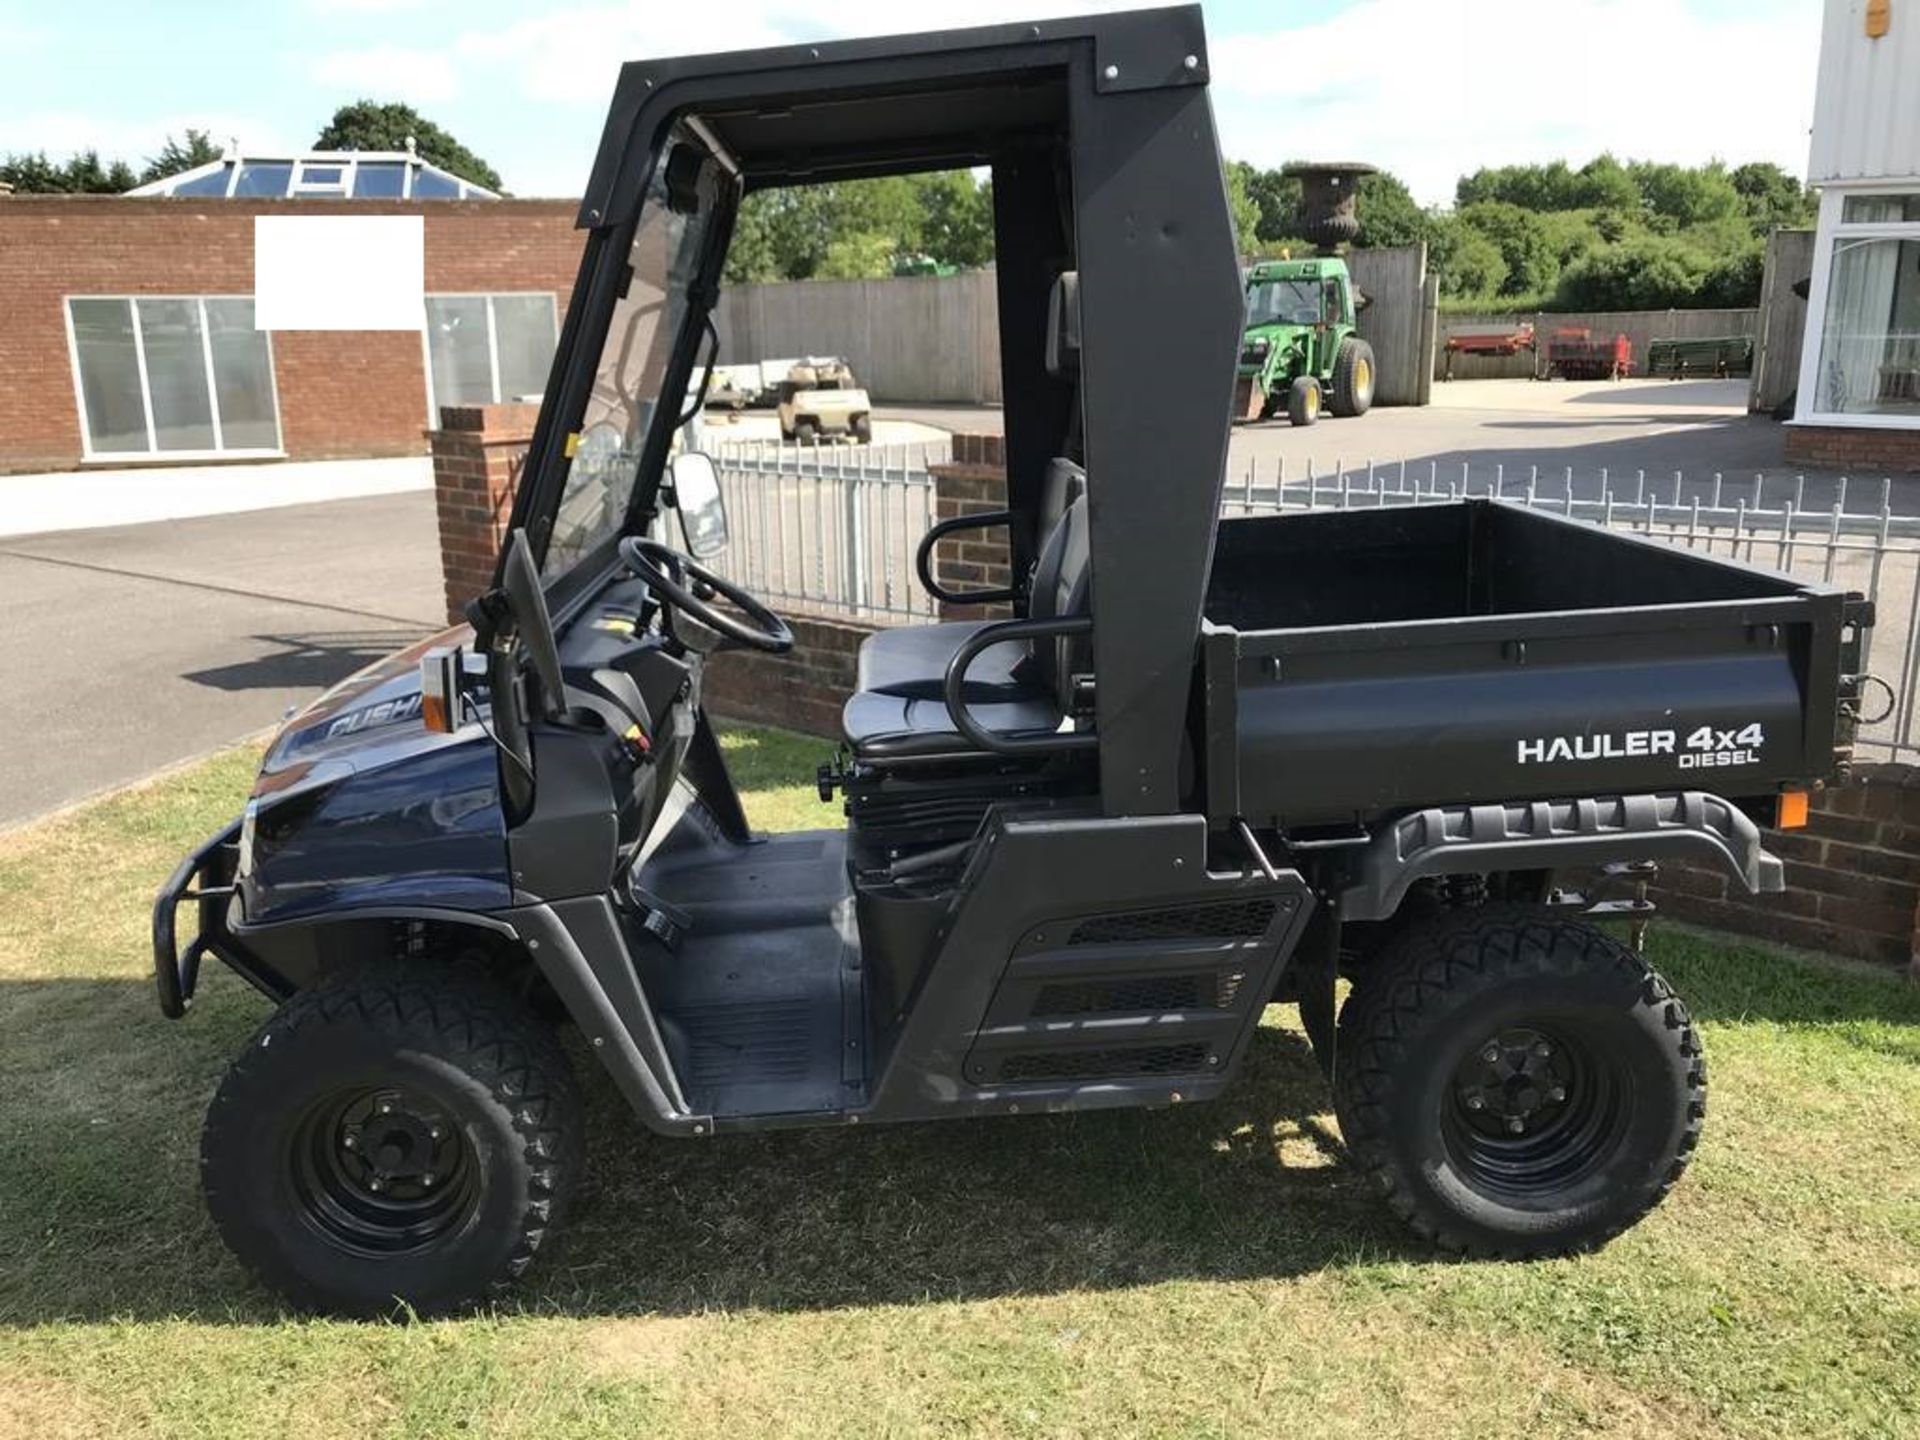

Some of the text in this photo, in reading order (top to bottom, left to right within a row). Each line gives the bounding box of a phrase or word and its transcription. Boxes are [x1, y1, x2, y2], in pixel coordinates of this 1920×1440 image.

[1517, 722, 1764, 763] HAULER 4x4
[1678, 749, 1760, 768] DIESEL
